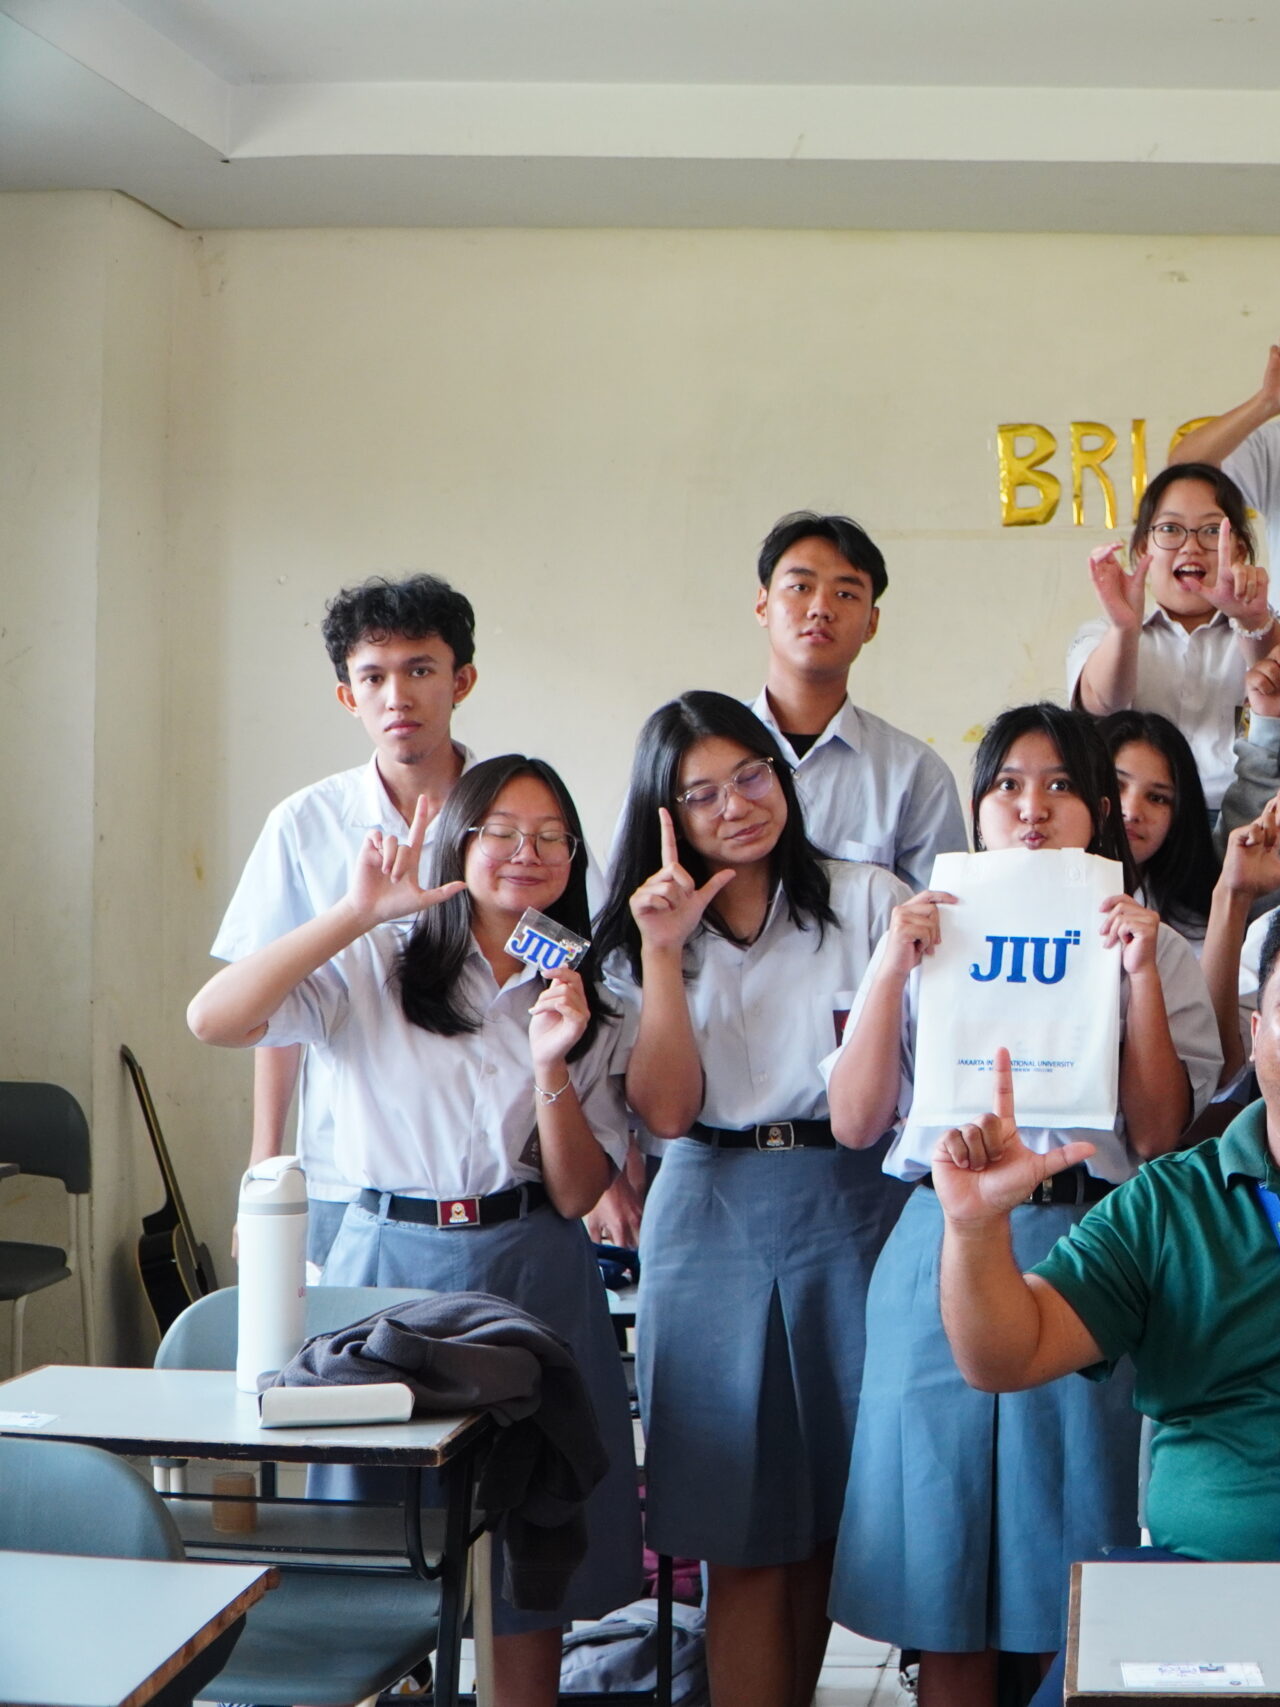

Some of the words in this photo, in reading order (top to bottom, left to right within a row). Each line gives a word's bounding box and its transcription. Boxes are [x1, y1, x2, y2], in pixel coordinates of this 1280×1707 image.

[511, 929, 570, 970] JIU
[969, 930, 1081, 984] JIU
[986, 1059, 1035, 1067] INATIONAL
[1037, 1060, 1075, 1068] UNIVERSITY
